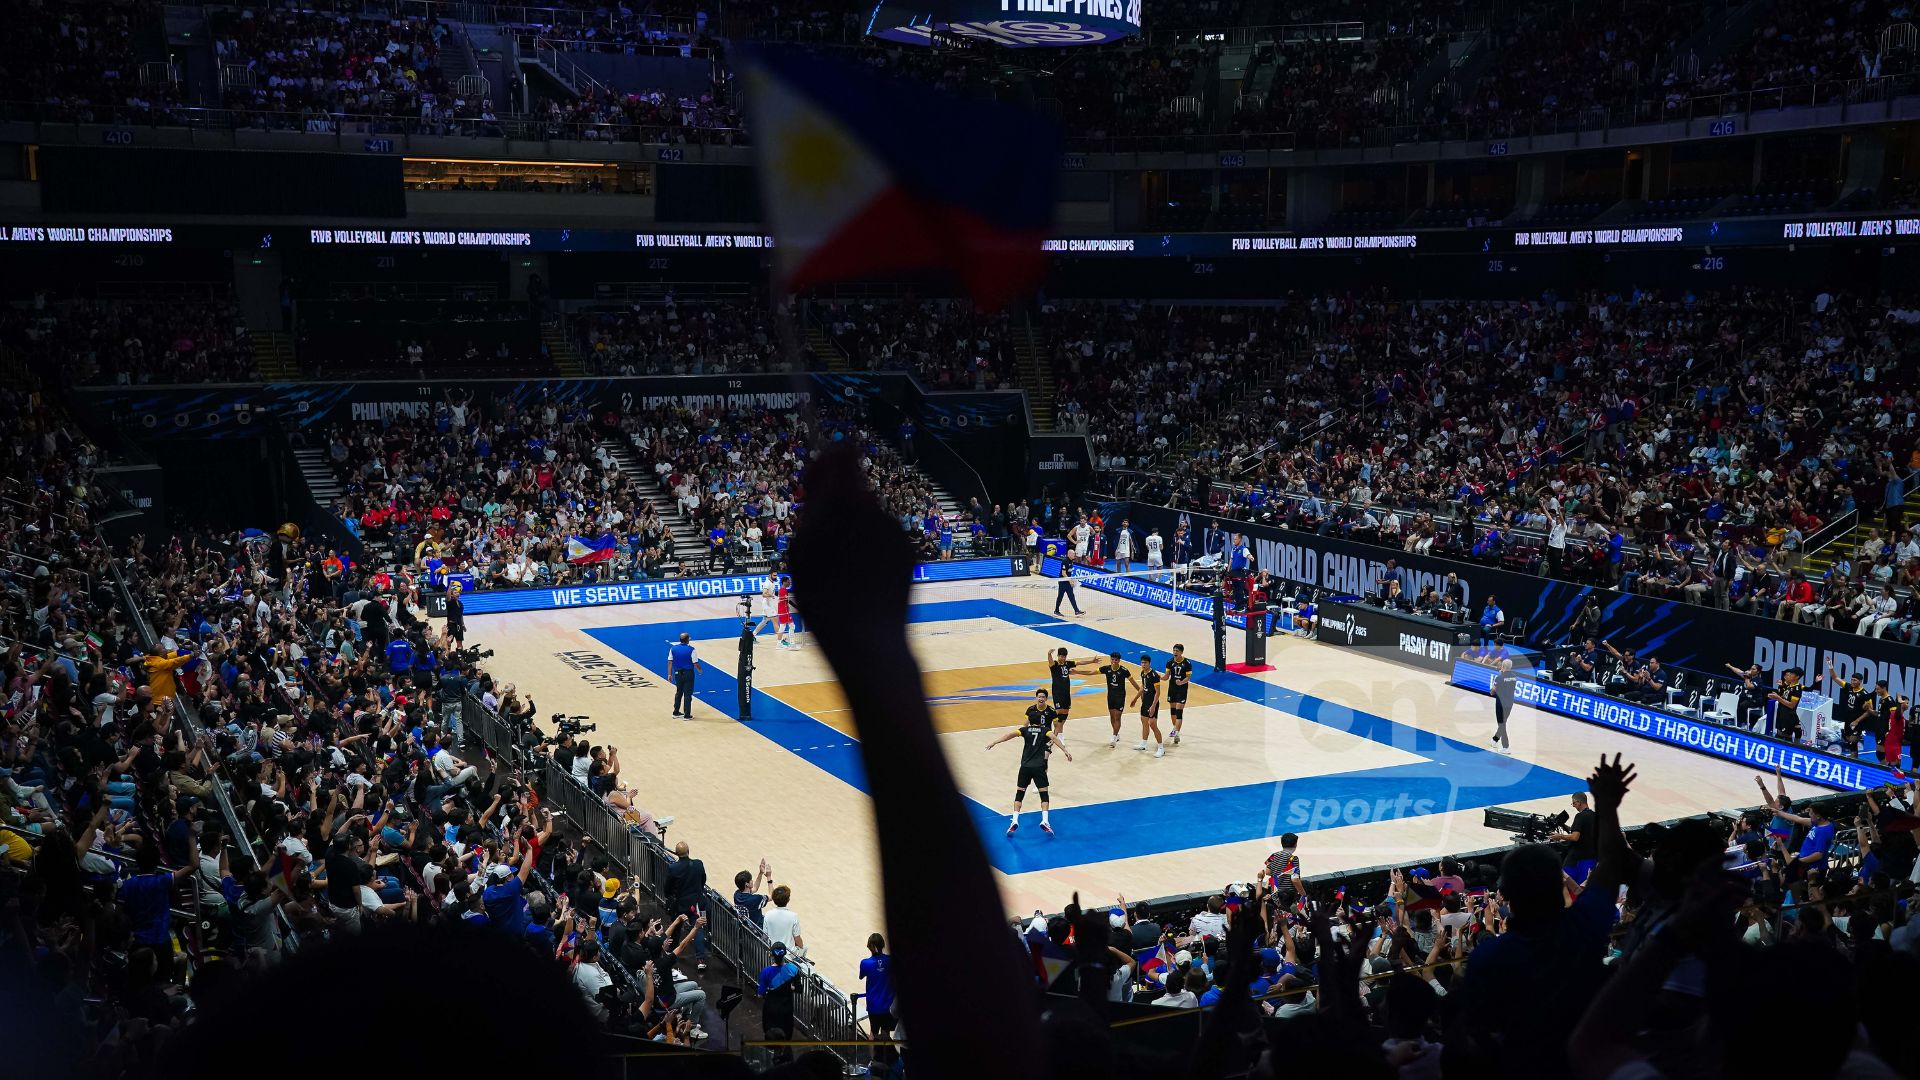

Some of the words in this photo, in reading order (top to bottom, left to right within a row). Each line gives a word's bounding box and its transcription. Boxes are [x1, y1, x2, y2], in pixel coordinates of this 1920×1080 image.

[1712, 121, 1733, 135] 416
[105, 131, 132, 143] 410
[370, 140, 389, 152] 411
[1490, 143, 1506, 156] 415
[661, 149, 680, 160] 412
[11, 227, 44, 241] MEN'S
[47, 228, 85, 241] WORLD
[88, 228, 173, 242] CHAMPIONSHIPS
[1805, 221, 1857, 237] VOLLEYBALL
[1859, 220, 1892, 236] MEN'S
[1895, 219, 1920, 235] WOR
[334, 230, 387, 243] VOLLEYBALL
[390, 231, 420, 244] MEN'S
[422, 232, 456, 245] WORLD
[458, 232, 531, 245] CHAMPIONSHIPS
[656, 235, 702, 247] VOLLEYBALL
[705, 236, 732, 247] MEN'S
[734, 236, 762, 247] WORLD
[1252, 238, 1297, 250] VOLLEYBALL
[1299, 237, 1323, 249] MEN'S
[1325, 237, 1352, 248] WORLD
[1354, 236, 1416, 248] CHAMPIONSHIPS
[1531, 232, 1567, 245] VOLLEYBALL
[1569, 231, 1592, 244] MEN'S
[1594, 230, 1620, 243] WORLD
[1621, 228, 1683, 242] CHAMPIONSHIPS
[1040, 240, 1067, 251] WORLD
[1069, 240, 1134, 251] CHAMPIONSHIPS
[1194, 263, 1214, 273] 214
[1489, 260, 1504, 271] 215
[1704, 257, 1724, 270] 216
[418, 387, 431, 395] 111
[728, 380, 742, 388] 112
[352, 401, 430, 421] PHILIPPINES
[1014, 559, 1024, 571] 15
[1256, 537, 1317, 586] WORLD
[1323, 551, 1471, 608] CHAMPONHP
[552, 589, 581, 605] WE
[585, 585, 643, 604] SERVE
[647, 583, 678, 600] THE
[683, 578, 744, 597] WORLD
[1101, 577, 1114, 590] THE
[1115, 579, 1145, 597] WORLD
[1146, 586, 1186, 608] THROUGH
[435, 597, 446, 610] 15
[1400, 632, 1427, 656] PASAY
[1430, 639, 1451, 662] CITY
[562, 650, 617, 670] LOVE
[605, 668, 658, 689] PASAY
[1173, 666, 1182, 675] 17
[581, 674, 625, 689] CITY
[1754, 636, 1920, 721] PHILIPPIN
[1031, 732, 1039, 746] 7
[1514, 680, 1559, 706] SERVE
[1563, 692, 1589, 716] THE
[1594, 702, 1650, 732] WORLD
[1655, 717, 1739, 756] THROUGH
[1744, 740, 1867, 790] VOLLEYBALL
